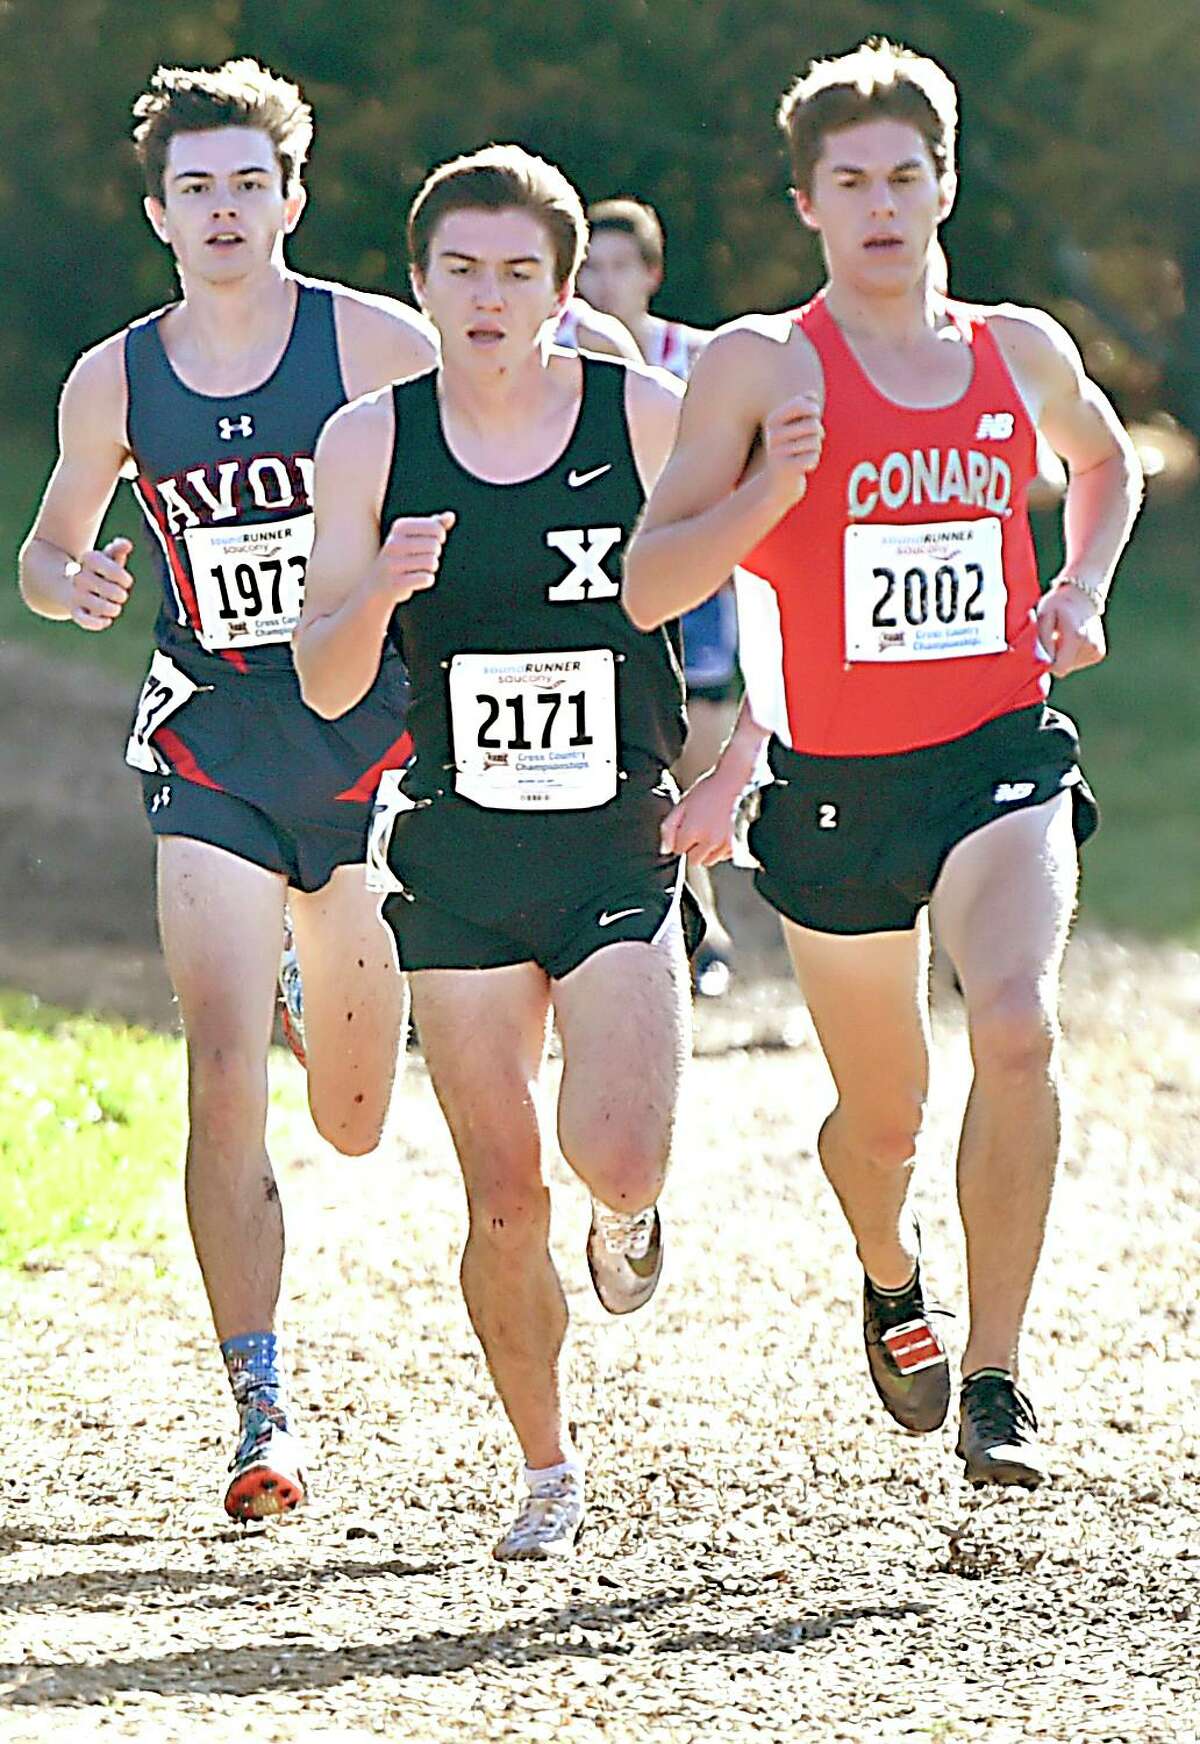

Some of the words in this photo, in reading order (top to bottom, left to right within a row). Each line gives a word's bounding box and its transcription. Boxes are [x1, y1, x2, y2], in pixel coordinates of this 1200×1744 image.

[547, 527, 621, 601] X
[872, 562, 985, 627] 2002
[476, 691, 593, 750] 2171
[819, 805, 836, 828] 2
